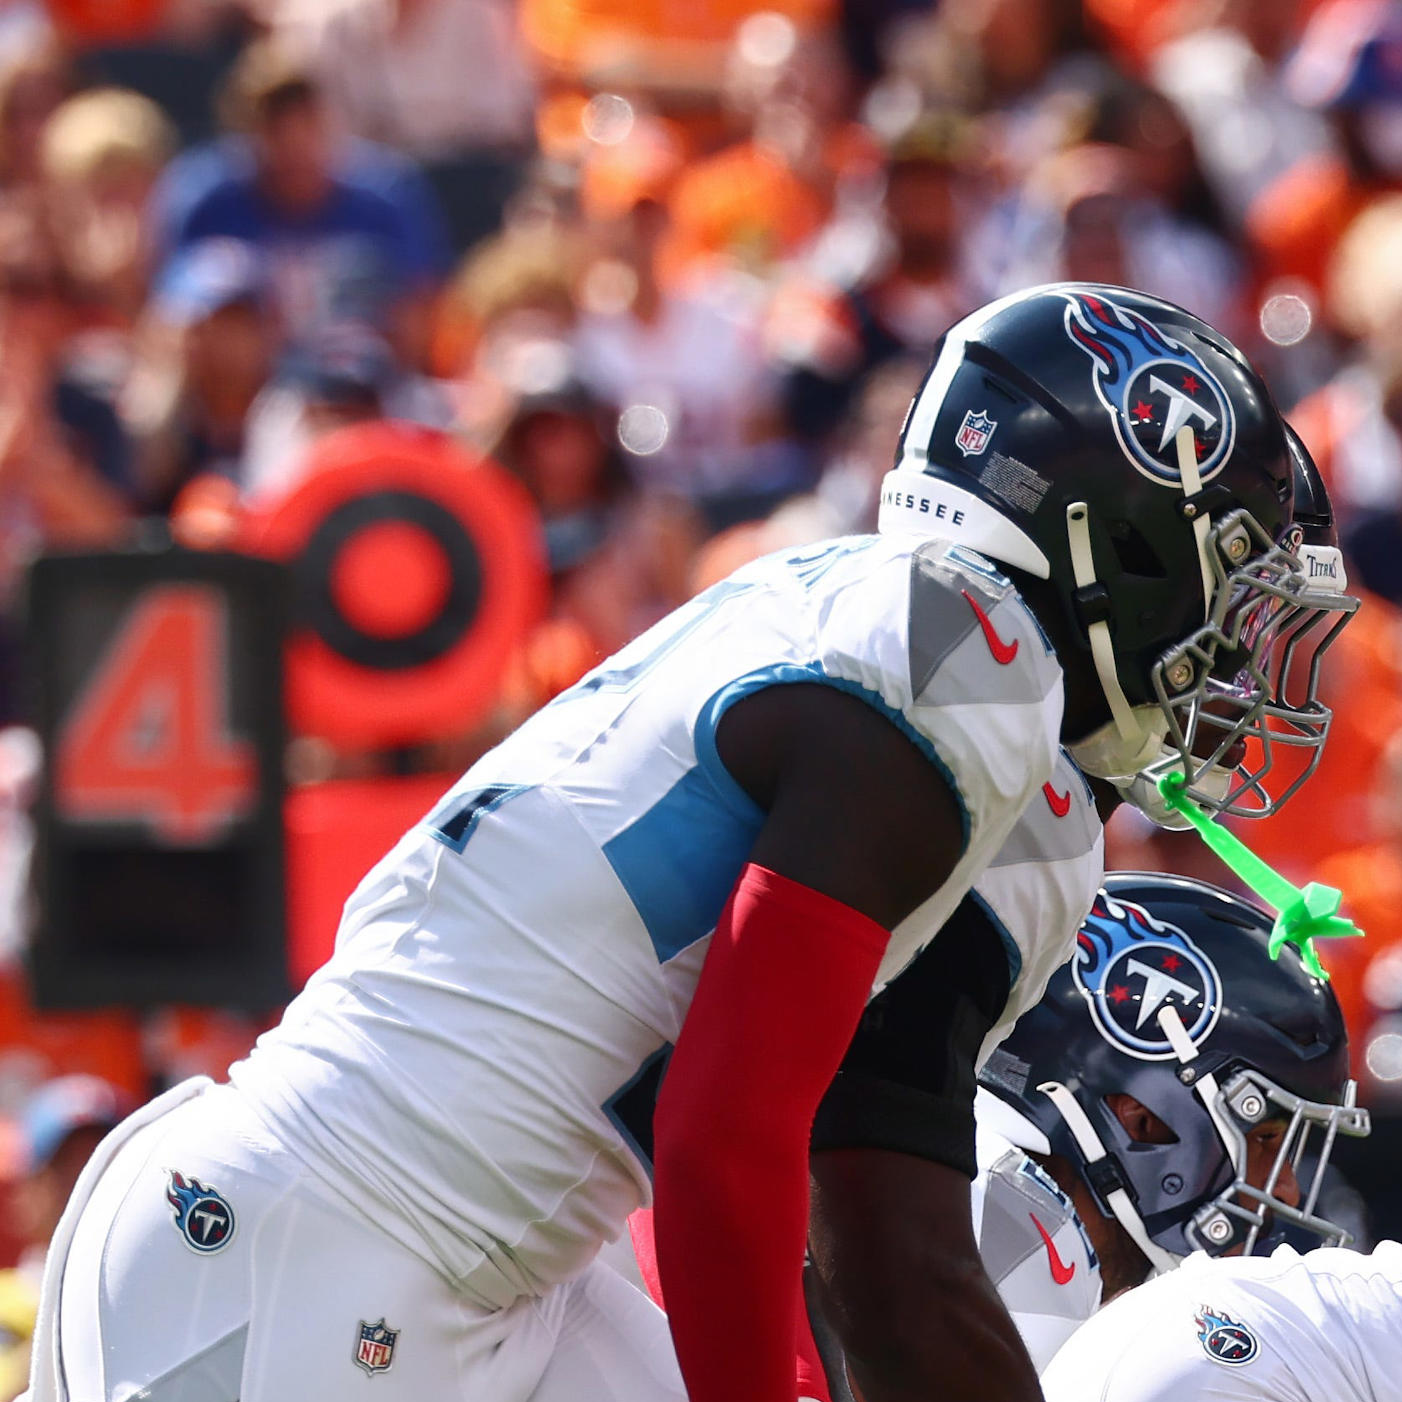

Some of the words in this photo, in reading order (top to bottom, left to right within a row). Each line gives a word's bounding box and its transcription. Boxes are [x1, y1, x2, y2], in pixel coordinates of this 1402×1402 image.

[959, 427, 984, 450] NFL
[54, 583, 260, 850] 4
[359, 1340, 389, 1367] NFL
